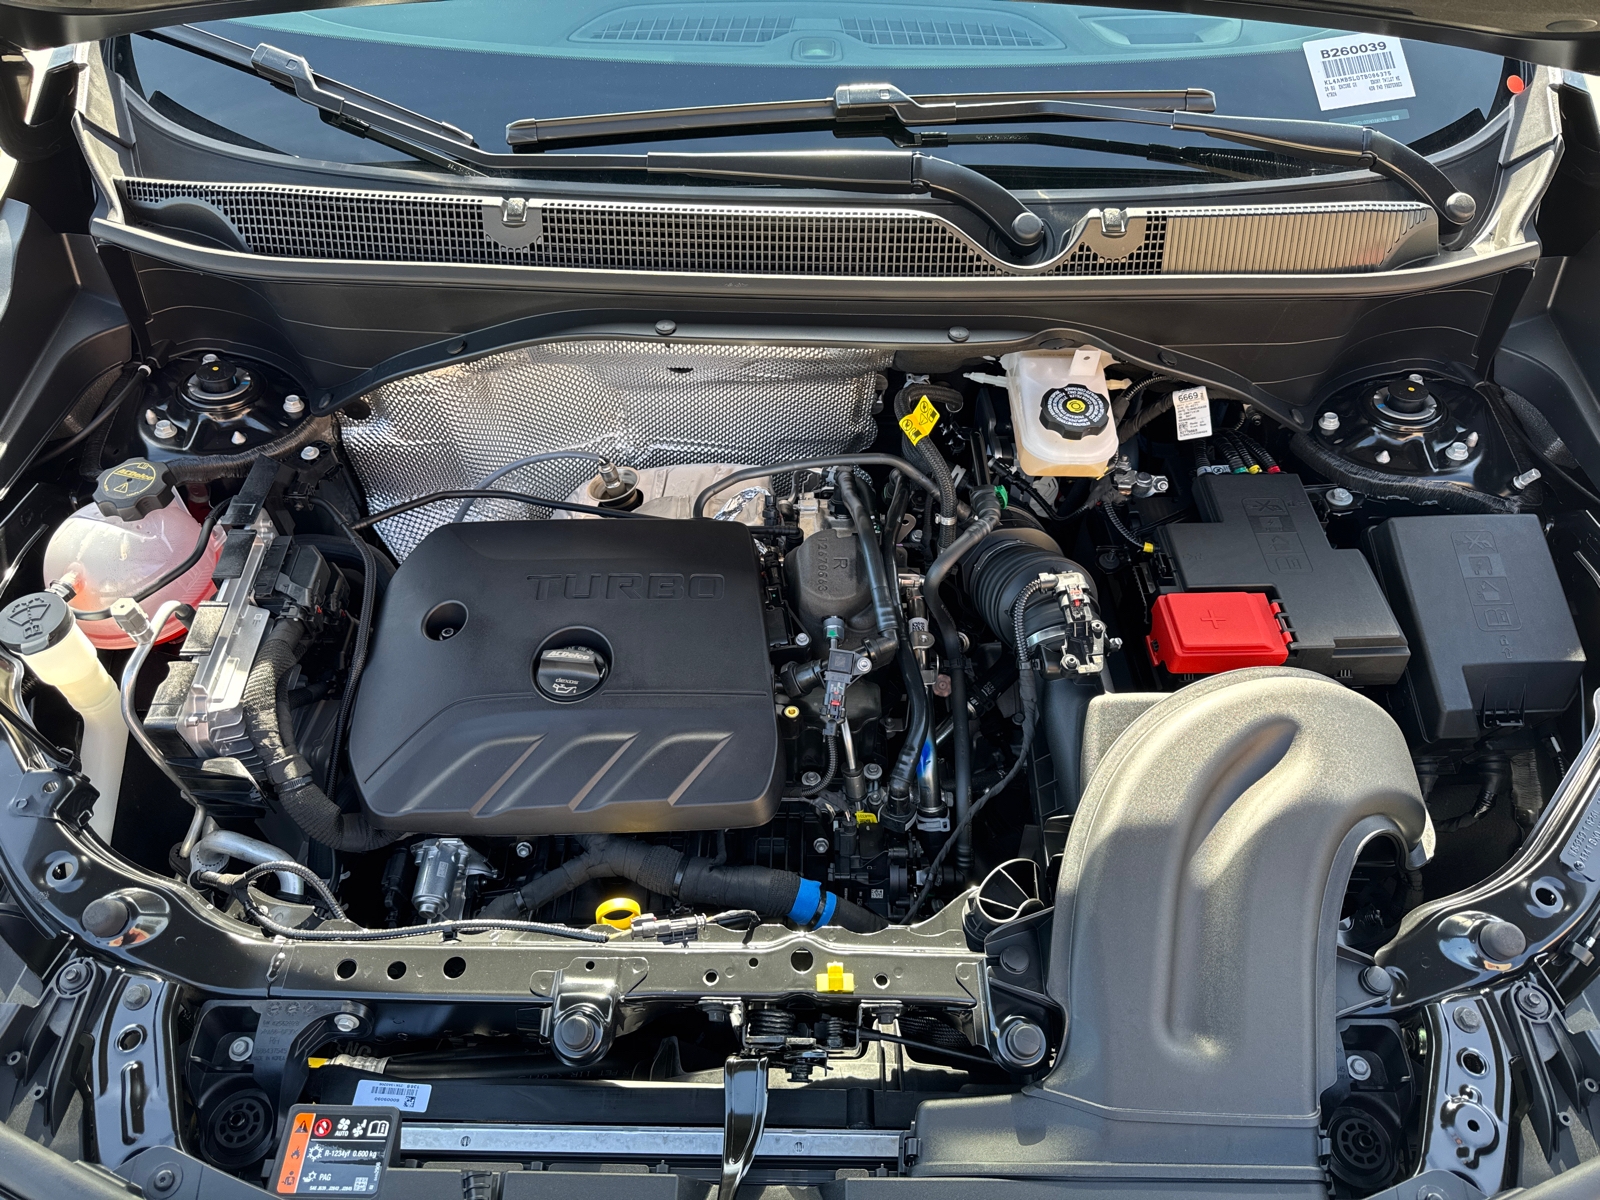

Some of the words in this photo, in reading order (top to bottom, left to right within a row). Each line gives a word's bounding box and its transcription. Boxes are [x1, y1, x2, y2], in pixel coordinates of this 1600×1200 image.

[1320, 41, 1387, 59] B260039
[1178, 392, 1198, 402] 6669
[114, 468, 154, 481] ACDelco
[817, 537, 828, 592] 12670663
[833, 556, 848, 570] R
[526, 572, 725, 601] TURBO
[546, 650, 590, 660] ACDelco
[324, 1150, 350, 1158] R-1234yf
